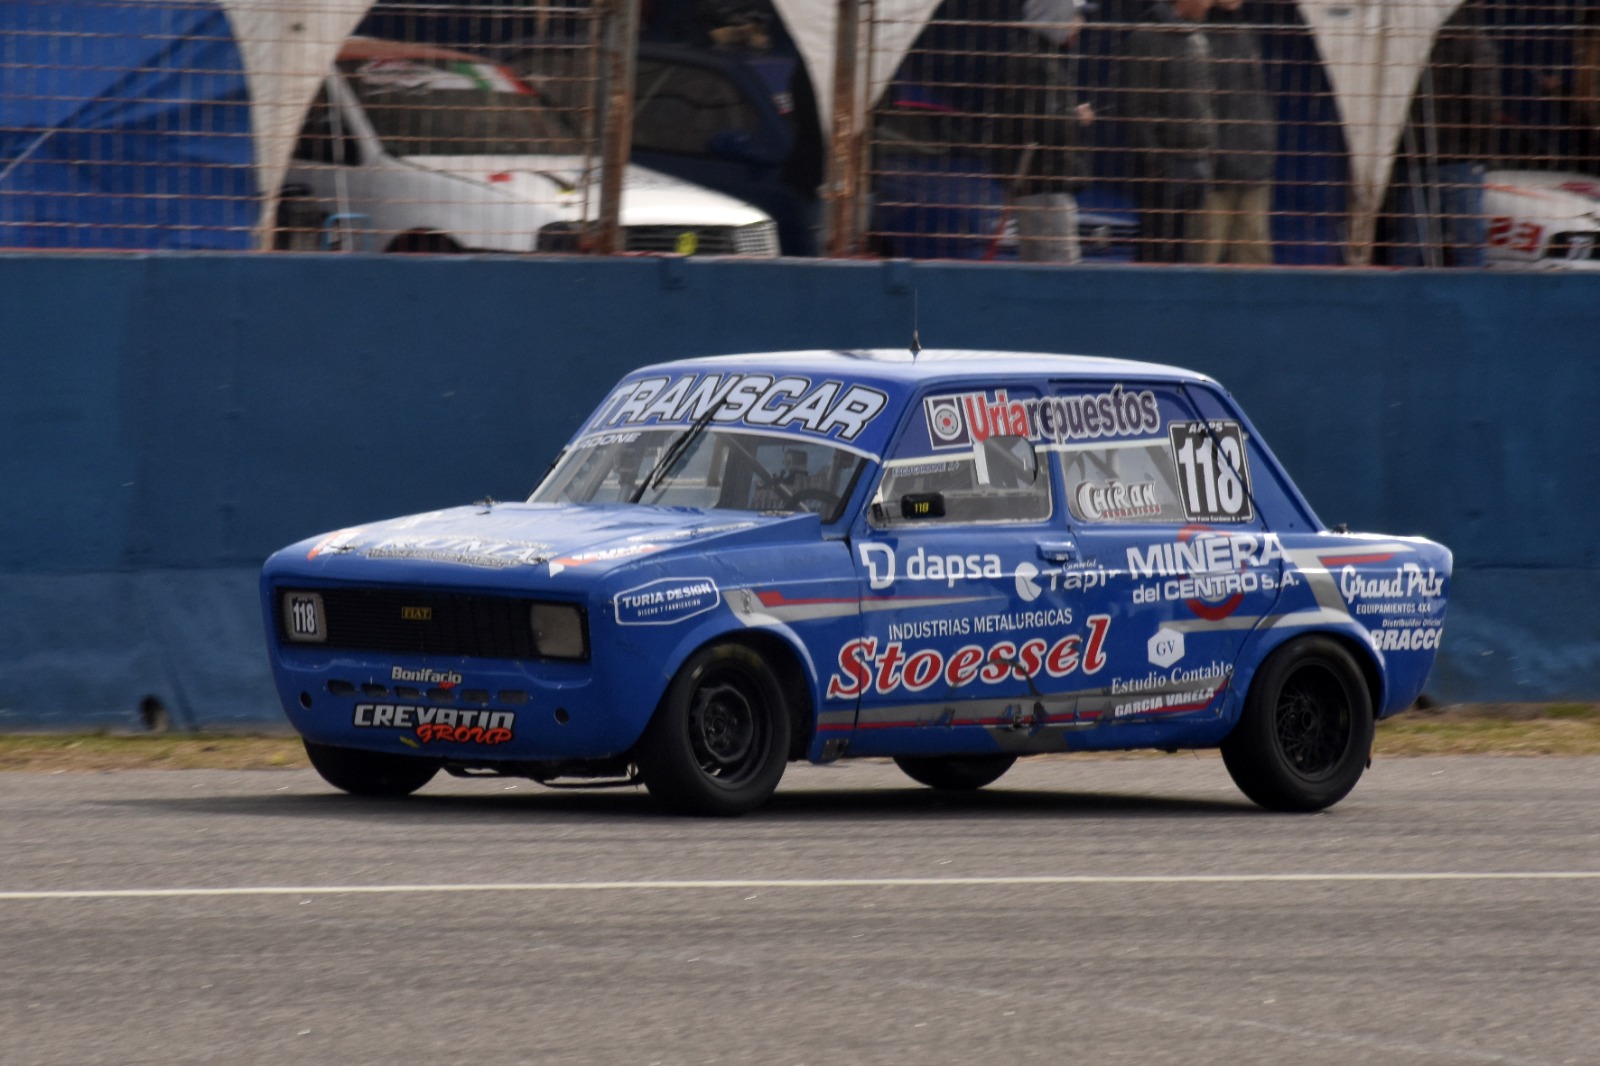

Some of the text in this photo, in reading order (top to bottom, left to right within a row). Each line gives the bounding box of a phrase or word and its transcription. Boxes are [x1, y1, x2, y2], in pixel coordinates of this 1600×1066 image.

[591, 373, 889, 442] TRANSCAR
[1178, 436, 1243, 514] 118
[914, 502, 929, 513] 118
[906, 547, 1001, 588] dapsa
[1126, 533, 1293, 580] MINERA
[1042, 564, 1121, 594] Tapir
[1132, 569, 1300, 604] del CENTRO S.A.
[1340, 562, 1444, 604] Grand Prix
[622, 582, 712, 609] TURIA DESIGN
[1356, 603, 1416, 615] EQUIPAMIENTOS
[293, 602, 316, 633] 118
[404, 609, 429, 619] FIAT
[888, 607, 1073, 641] INDUSTRIAS METALURGICAS
[825, 614, 1111, 701] Stoessel
[1156, 639, 1175, 657] GV
[391, 666, 463, 685] Bonifacio
[1111, 660, 1233, 695] Estudio Contable
[1115, 686, 1215, 717] GARCIA VARELA
[416, 722, 513, 745] GROUP
